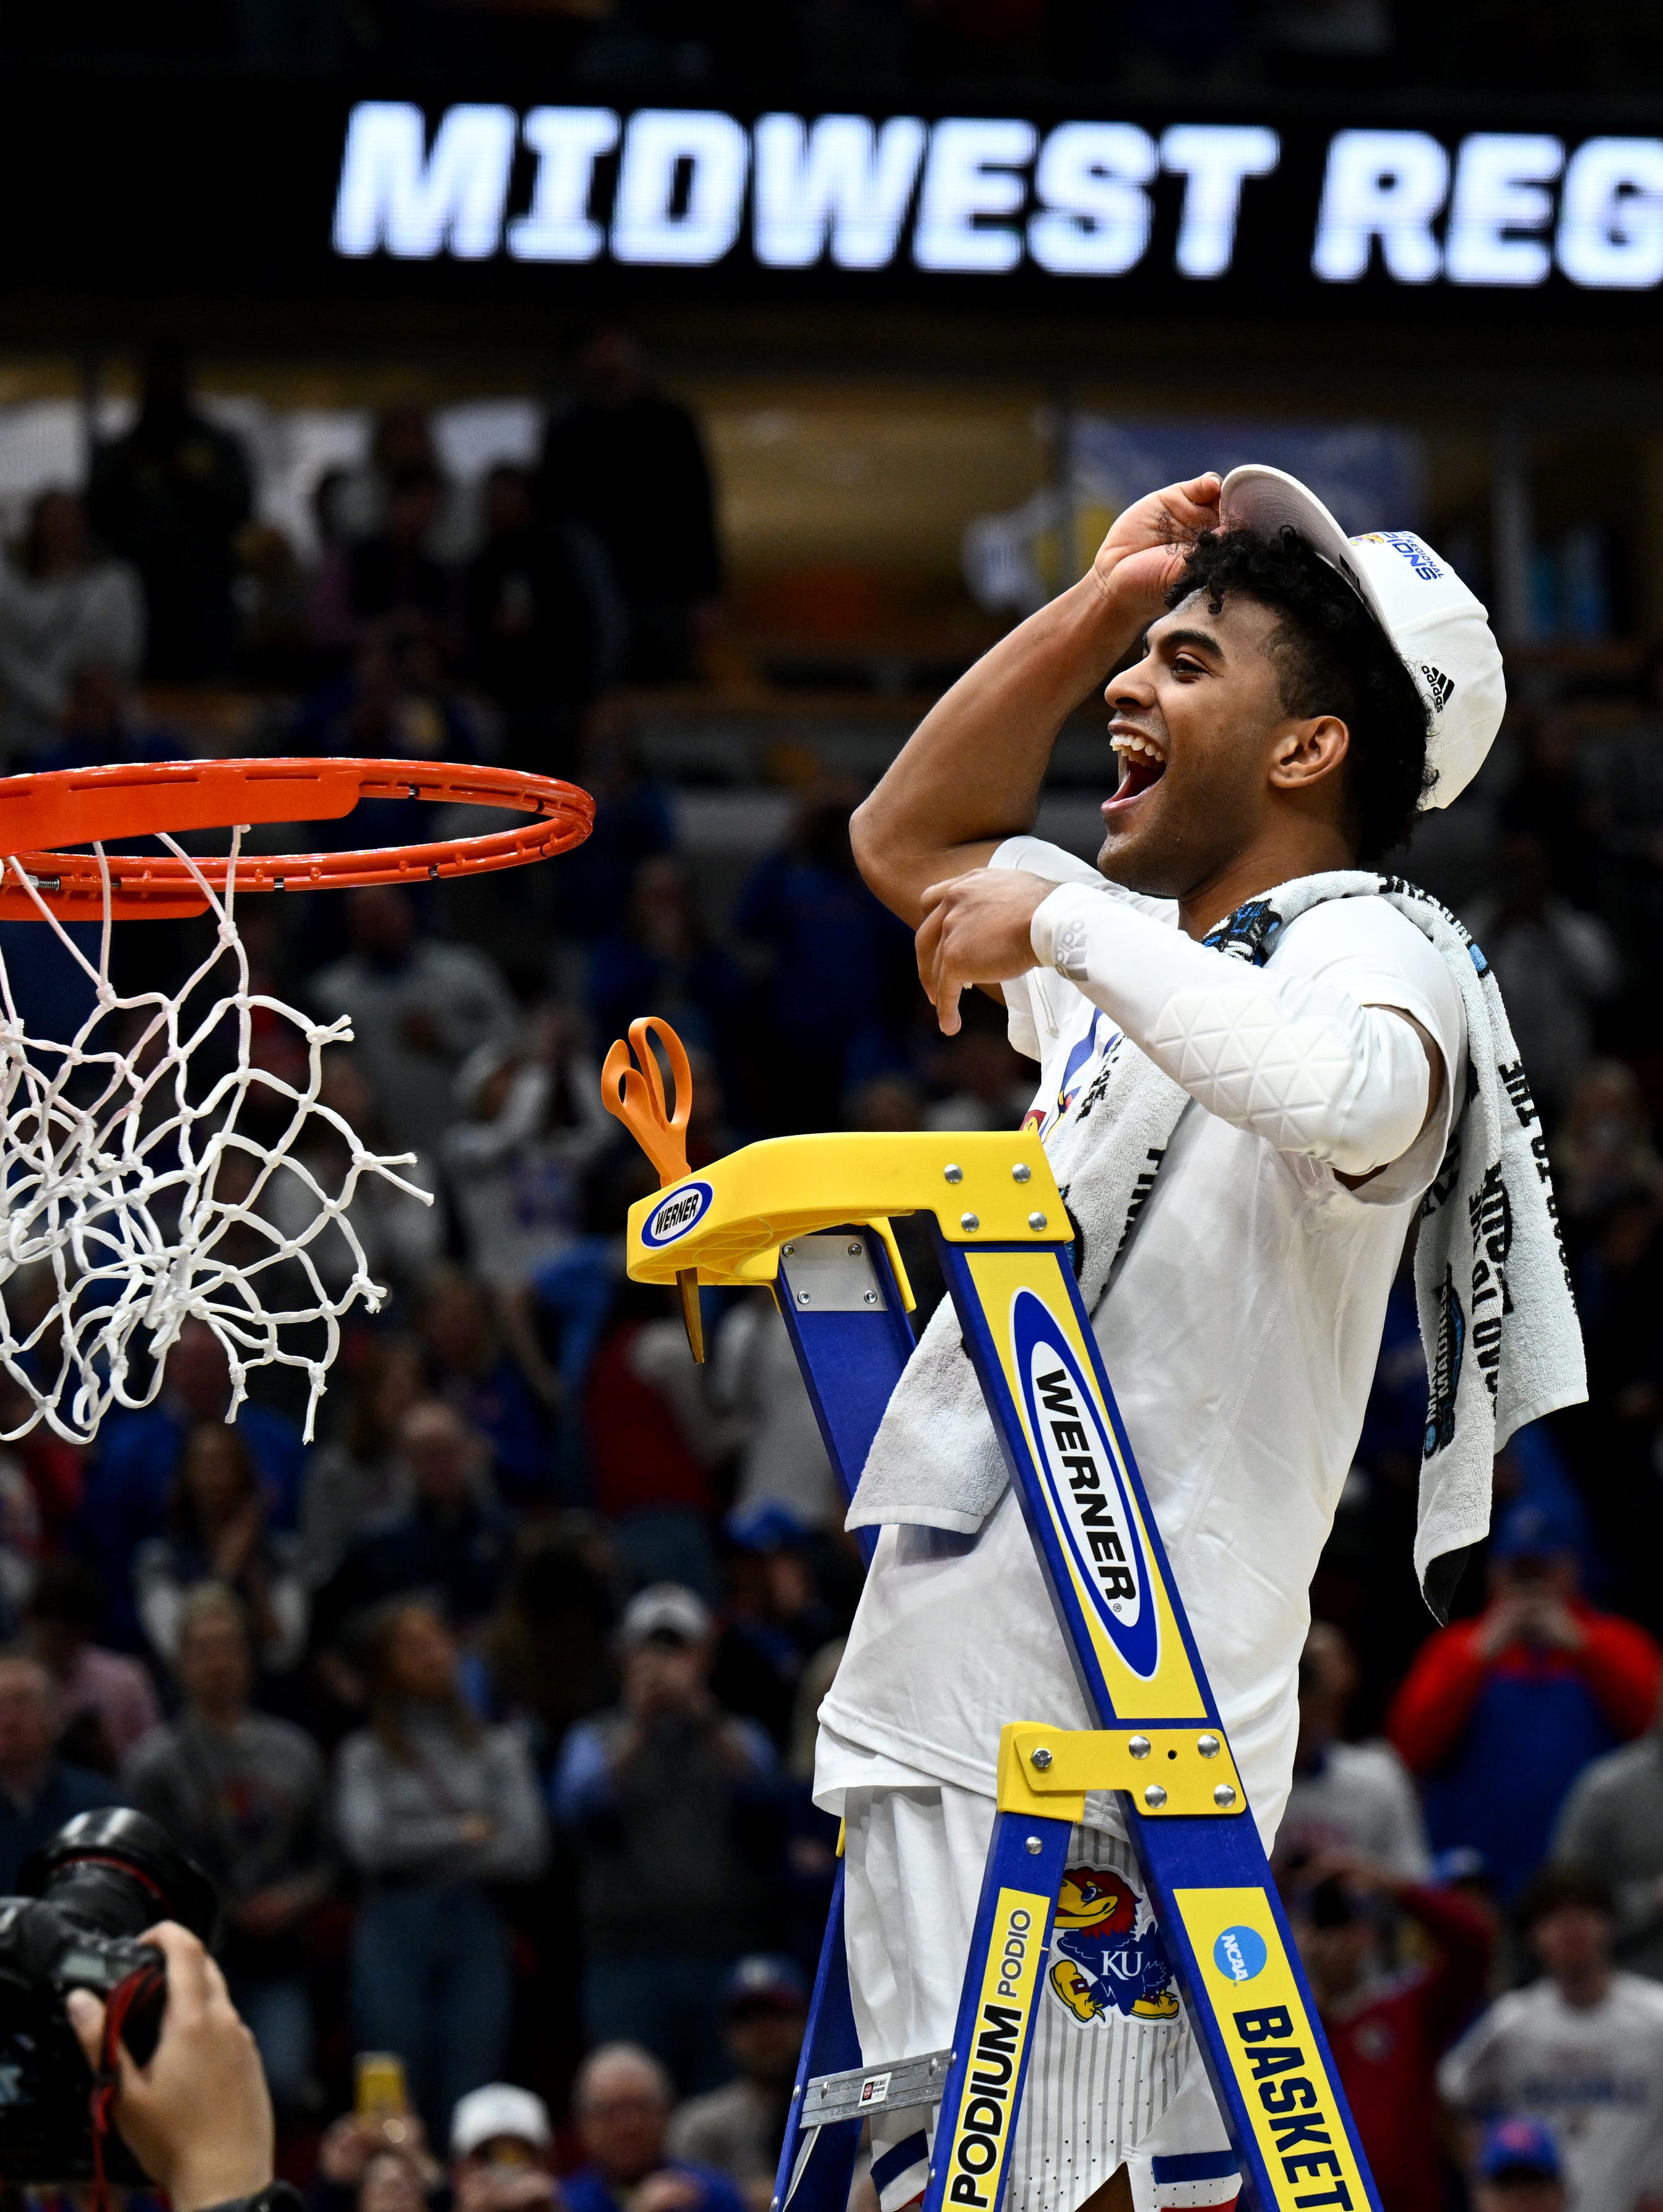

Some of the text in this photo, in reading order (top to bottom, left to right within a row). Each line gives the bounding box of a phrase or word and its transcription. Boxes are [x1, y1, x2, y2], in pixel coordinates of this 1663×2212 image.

[333, 101, 1663, 289] MIDWEST REG
[1405, 539, 1445, 579] REGIONAL
[1421, 665, 1443, 713] adidas
[655, 1193, 699, 1235] WERNER
[1101, 1951, 1143, 1980] KU
[1221, 1934, 1248, 1981] NCAA
[949, 1909, 1031, 2208] PODIUM PODIO
[1233, 2005, 1354, 2211] BASKET
